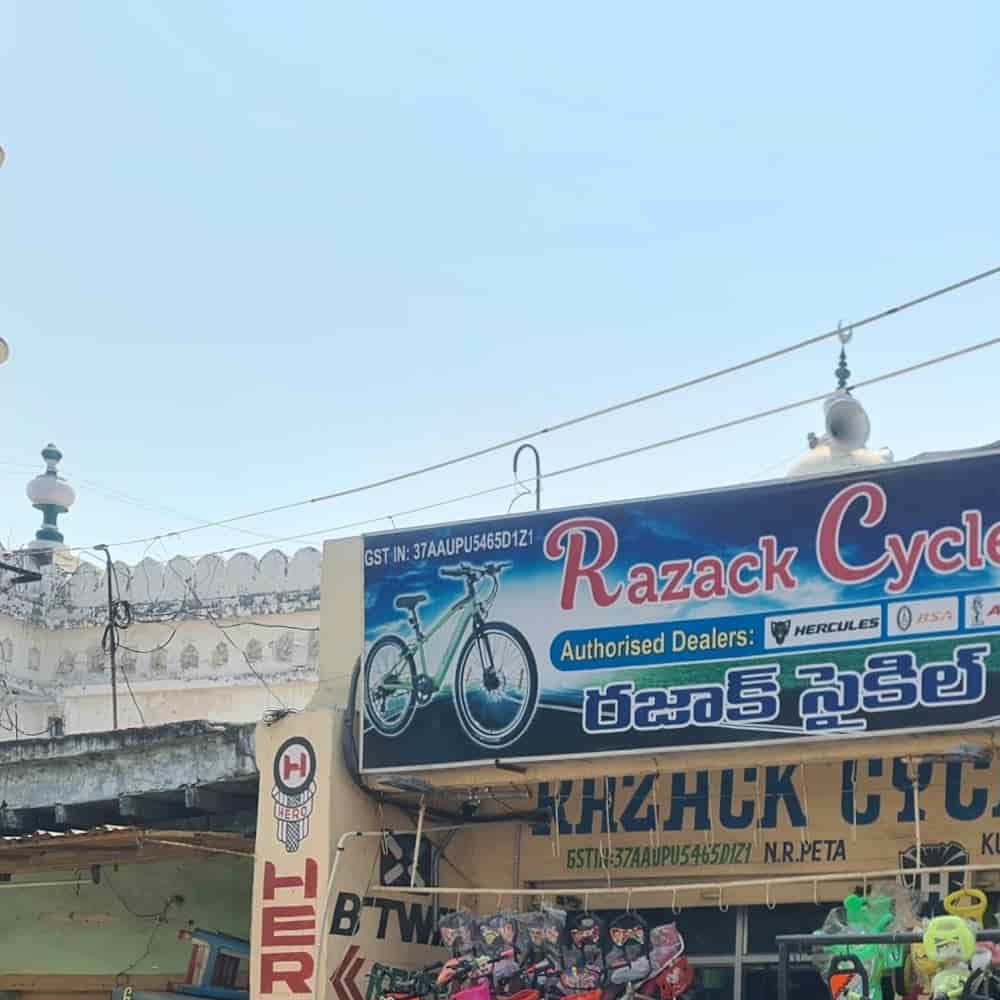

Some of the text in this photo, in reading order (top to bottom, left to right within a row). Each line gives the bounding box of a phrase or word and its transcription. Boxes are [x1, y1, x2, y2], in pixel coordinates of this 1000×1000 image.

[364, 528, 534, 567] GST IN: 37AAUPU5465D1Z1
[544, 516, 799, 612] Razack
[794, 616, 881, 638] HERCULES
[916, 610, 952, 625] BSA
[560, 625, 756, 662] Authorised Dealers:
[582, 663, 781, 735] రజాక్
[796, 643, 992, 731] సైకిల్
[278, 805, 308, 820] HERO
[329, 890, 448, 948] BTW
